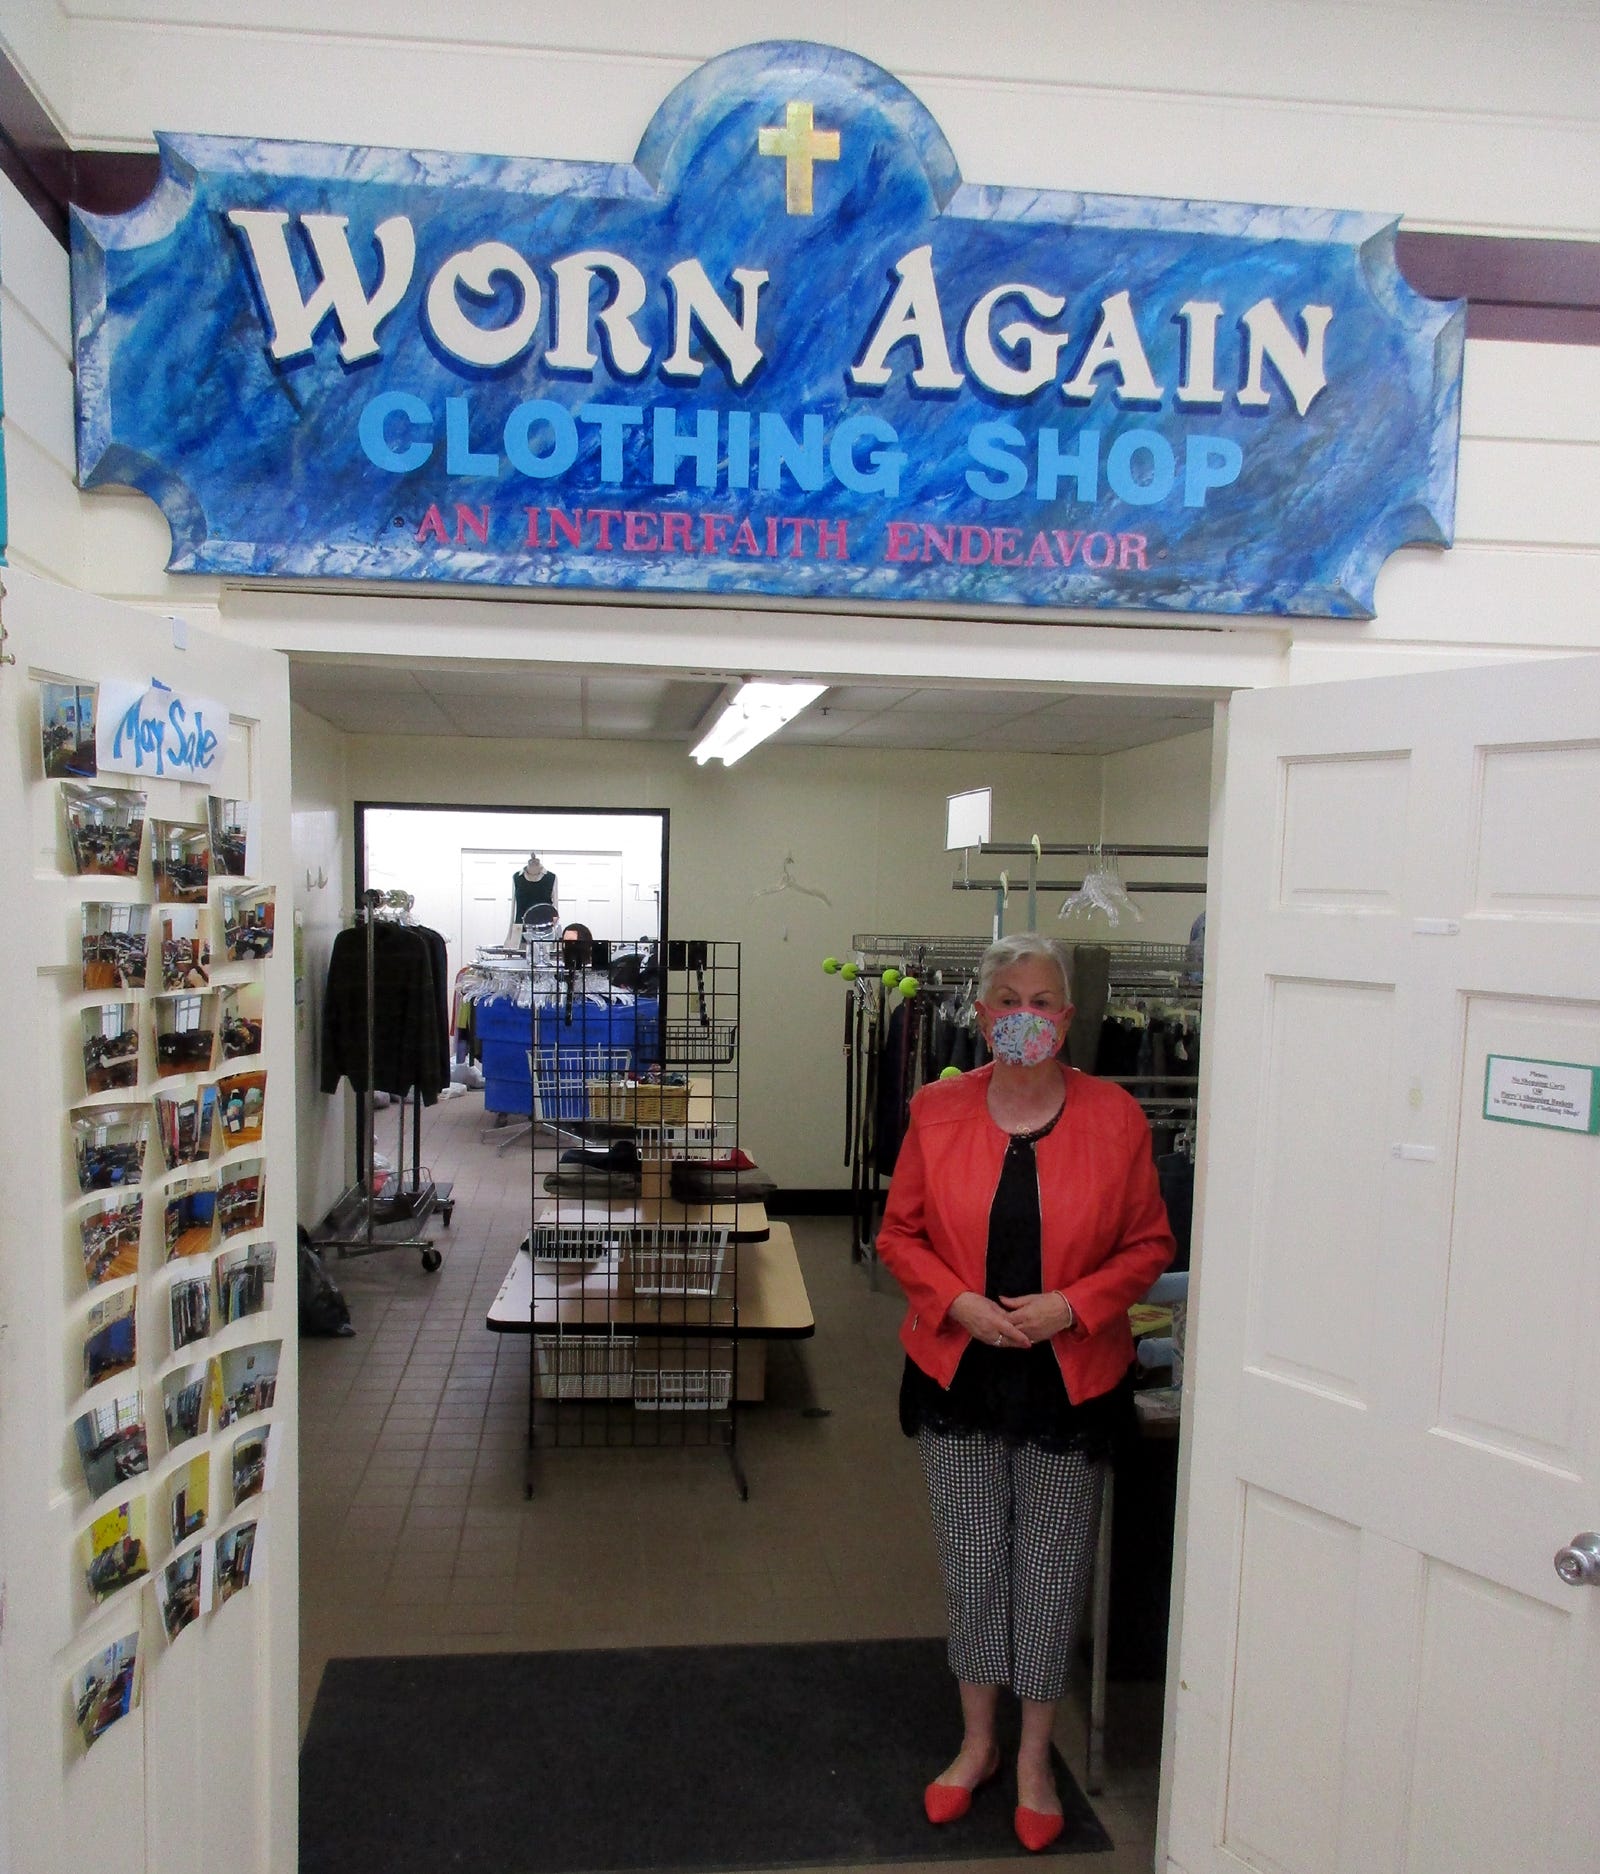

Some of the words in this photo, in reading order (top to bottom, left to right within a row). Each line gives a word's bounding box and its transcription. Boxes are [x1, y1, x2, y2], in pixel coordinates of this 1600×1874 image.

[227, 209, 769, 386] WORN
[852, 244, 1333, 417] AGAIN
[359, 391, 908, 498] CLOTHING
[965, 421, 1243, 507] SHOP
[414, 503, 490, 545] AN
[524, 507, 849, 560] INTERFAITH
[884, 522, 1149, 571] ENDEAVOR
[113, 694, 165, 775] May
[166, 699, 217, 773] Sale
